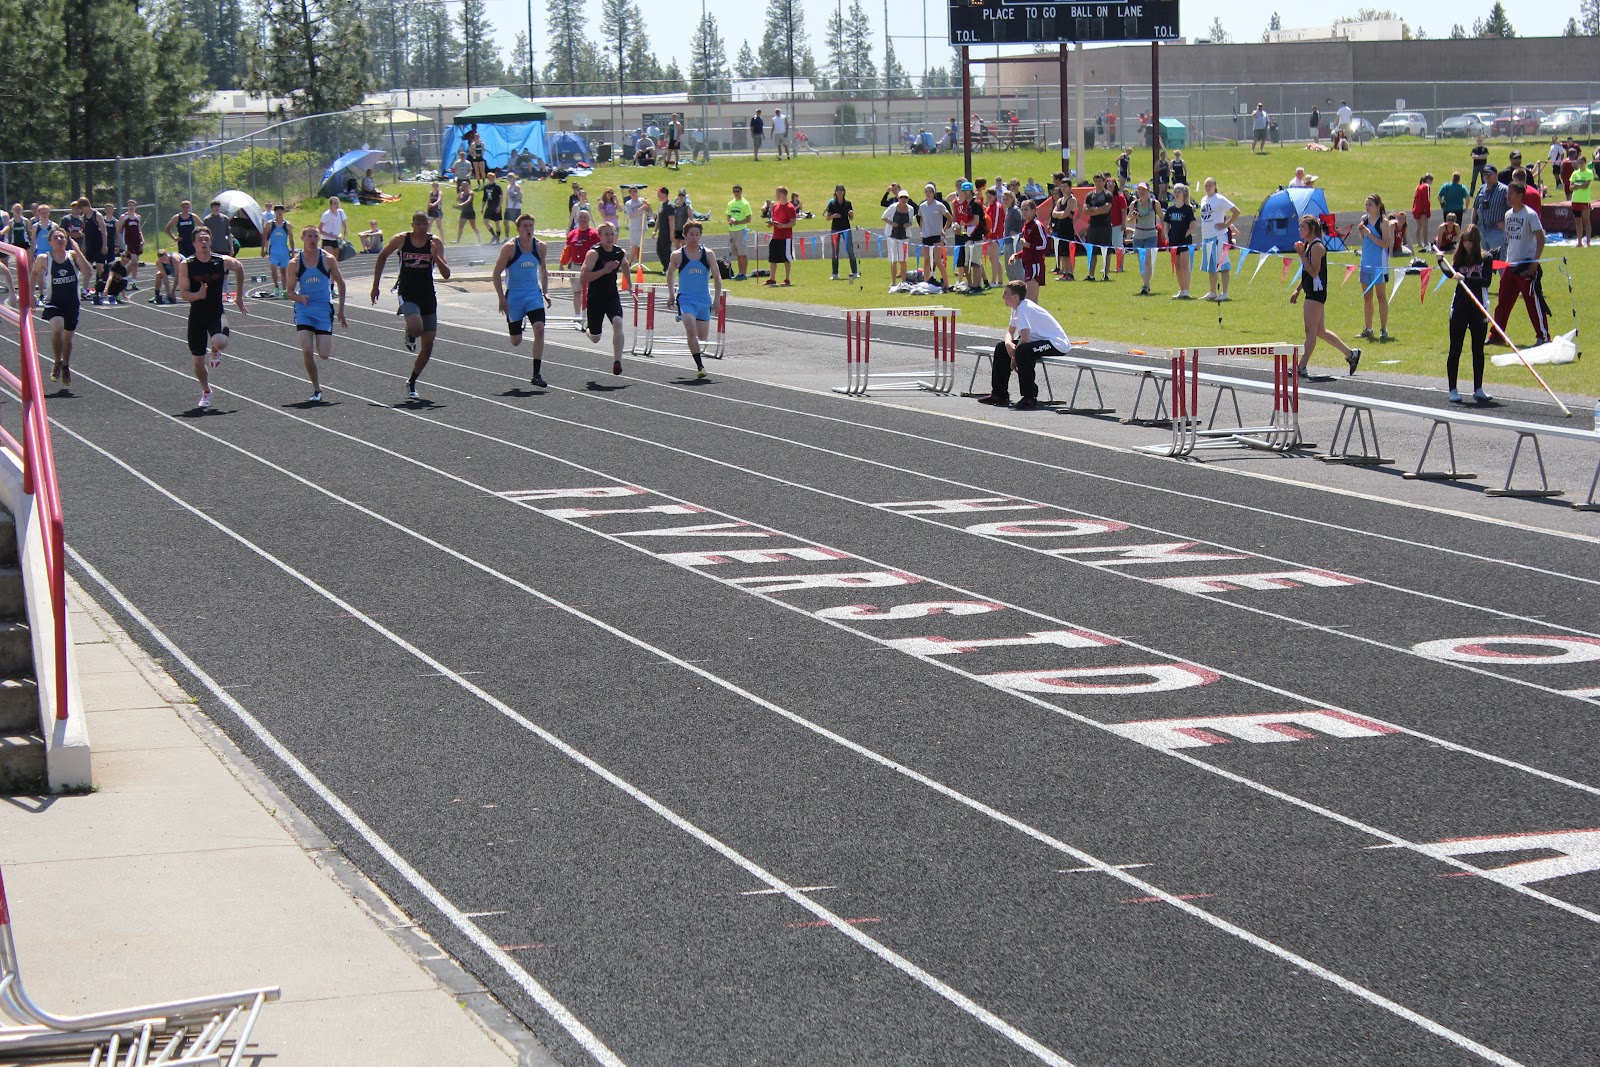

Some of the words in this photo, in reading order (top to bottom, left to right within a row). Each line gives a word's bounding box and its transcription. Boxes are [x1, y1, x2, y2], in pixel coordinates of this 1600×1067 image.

[983, 8, 1015, 20] PLACE
[1026, 7, 1038, 19] TO
[1043, 7, 1057, 18] GO
[1071, 6, 1093, 17] BALL
[1097, 6, 1108, 17] ON
[1117, 6, 1143, 17] LANE
[956, 30, 981, 42] T.O.L.
[1154, 26, 1178, 37] T.O.L.
[886, 309, 936, 317] RIVERSIDE
[1217, 346, 1275, 356] RIVERSIDE
[866, 496, 1367, 593] HOME
[495, 484, 1401, 753] RIVERSIDE
